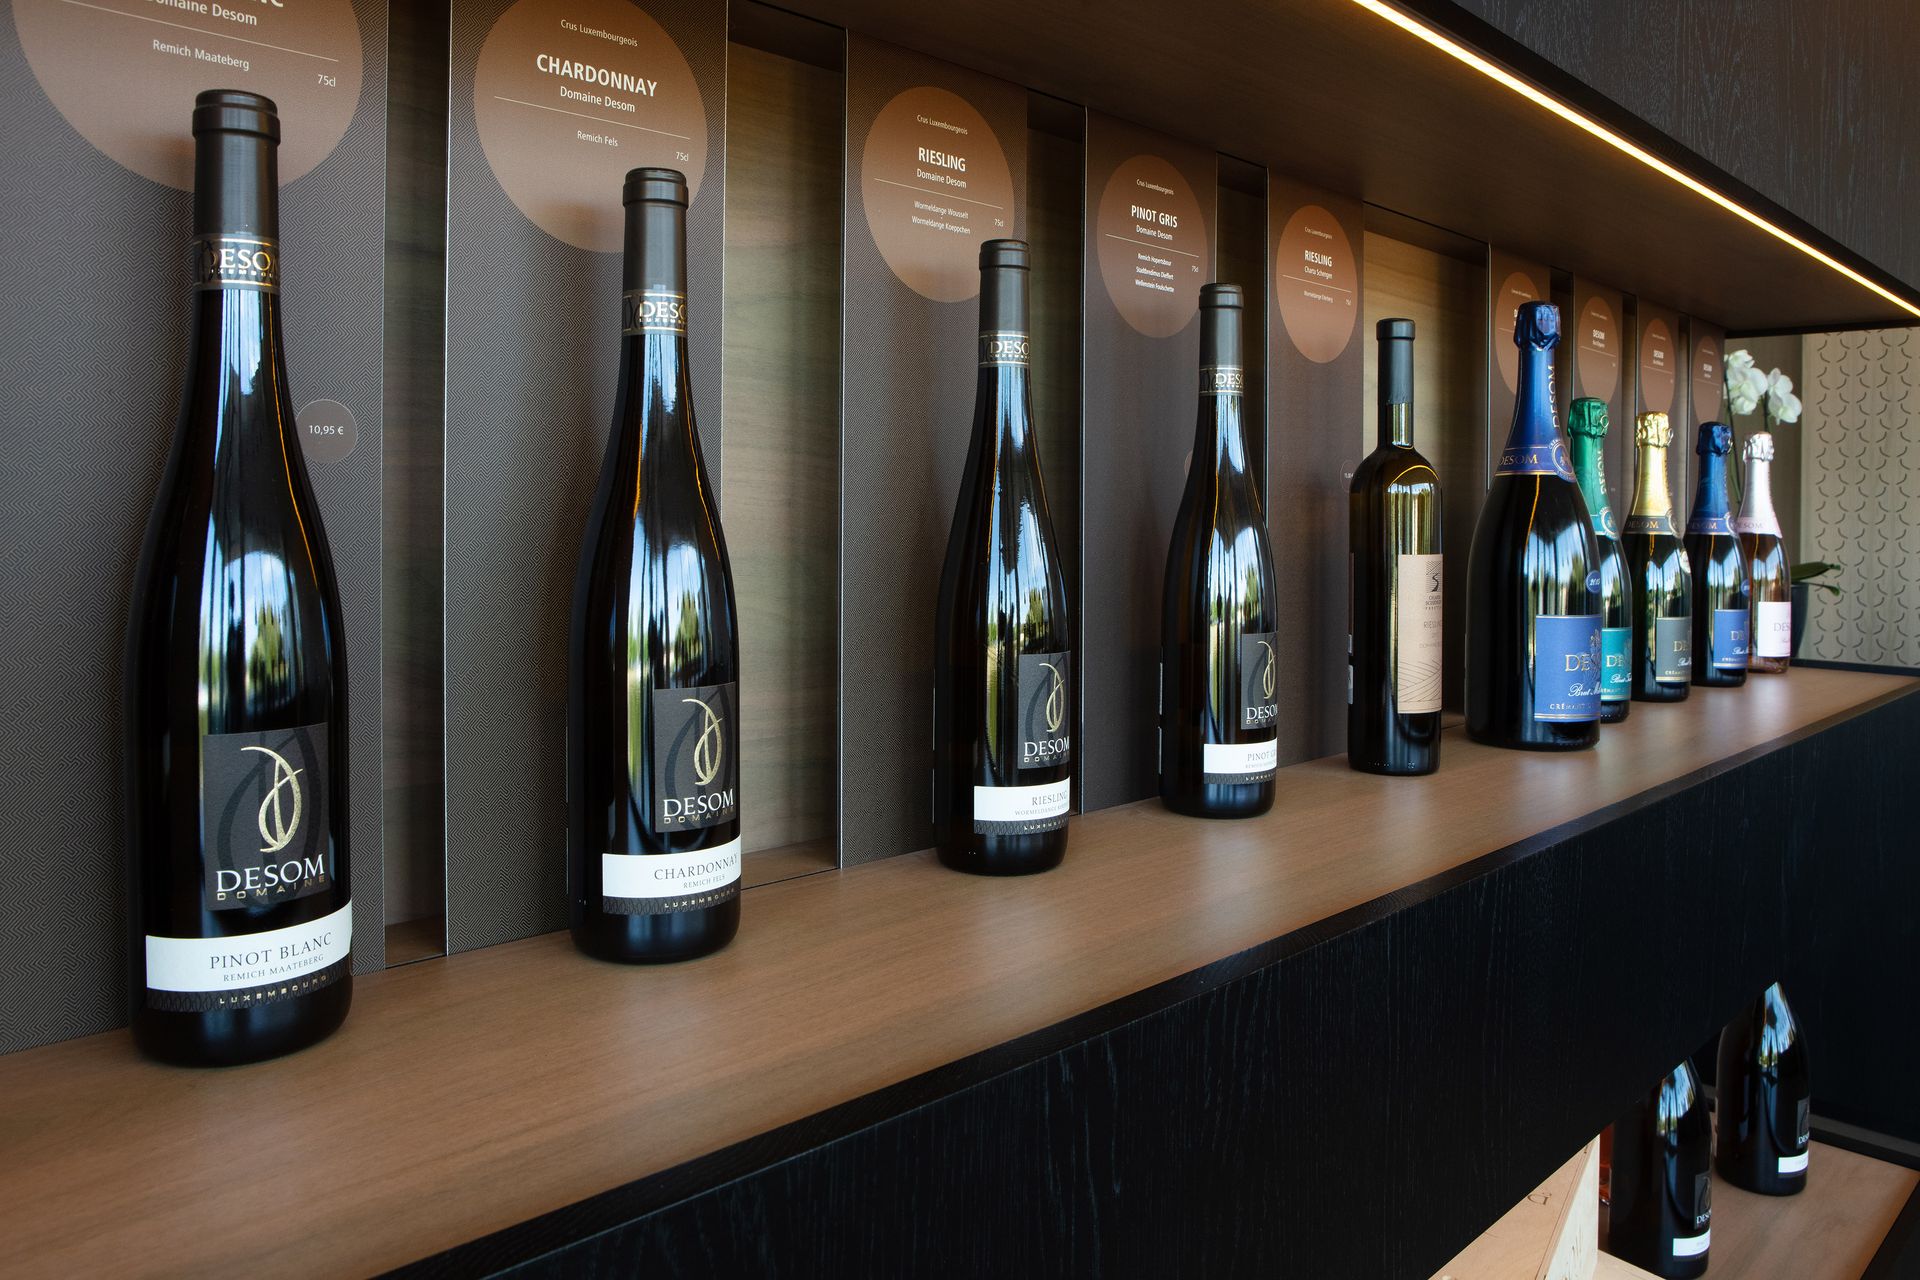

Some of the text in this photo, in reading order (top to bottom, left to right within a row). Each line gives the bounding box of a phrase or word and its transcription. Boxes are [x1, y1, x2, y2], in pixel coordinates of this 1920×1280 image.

[147, 0, 208, 14] maine
[212, 3, 257, 26] Desom
[560, 19, 638, 47] Crus Luxembourgeois
[153, 39, 250, 72] Remich Maateberg
[317, 73, 337, 88] 75cl
[536, 53, 658, 97] CHARDONNAY
[560, 86, 636, 113] Domaine Desom
[577, 130, 618, 147] Remich Fels
[675, 151, 689, 162] 75cl
[918, 146, 966, 172] RIESLING
[917, 168, 967, 189] Domaine Desom
[911, 215, 945, 231] Wormeldange
[1131, 204, 1178, 228] PINOT GRIS
[1136, 224, 1173, 241] Domaine Desom
[1304, 249, 1333, 267] RIESLING
[308, 425, 344, 436] 10,95 €
[1023, 735, 1070, 757] DESOM
[663, 788, 734, 817] DESOM
[663, 807, 735, 825] DOMAINE
[216, 853, 325, 893] DESOM
[654, 852, 738, 881] CHARDONNAY
[217, 874, 326, 901] DOMAINE
[683, 877, 711, 889] REMICH
[209, 931, 332, 970] PINOT BLANC
[223, 953, 324, 983] REMICH MAATEBERG
[219, 975, 327, 1004] LUXEMBOURG
